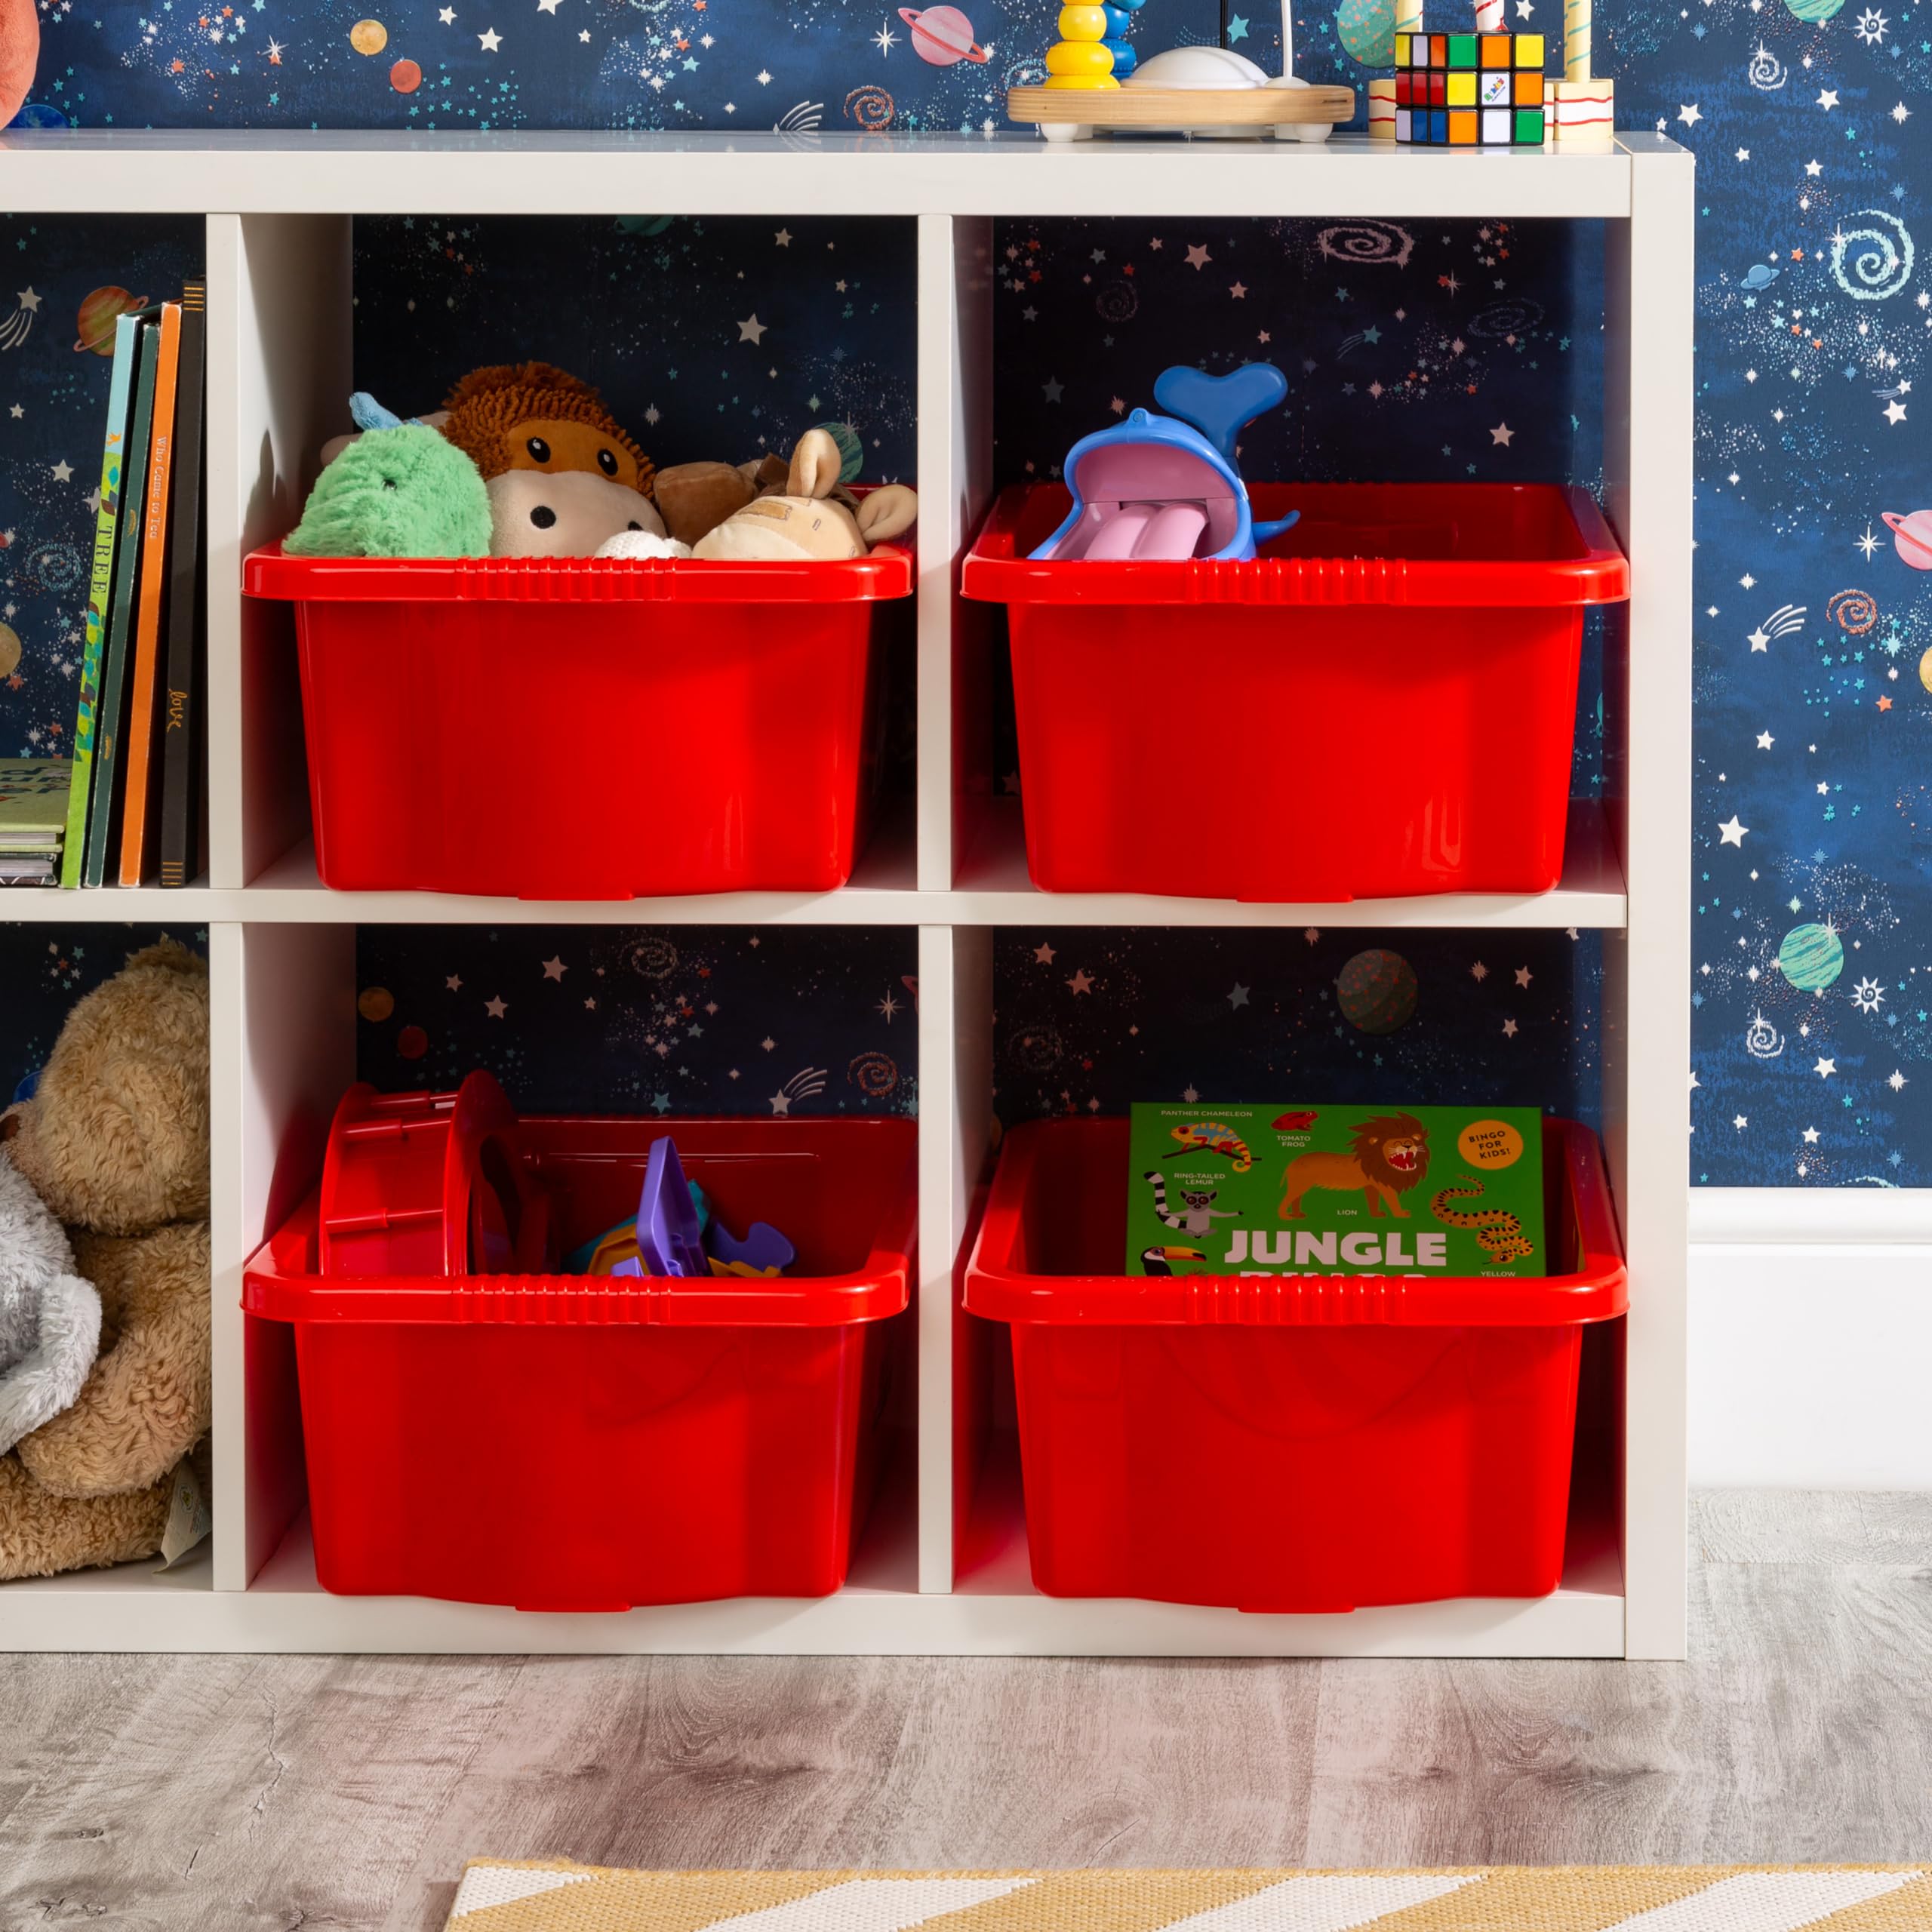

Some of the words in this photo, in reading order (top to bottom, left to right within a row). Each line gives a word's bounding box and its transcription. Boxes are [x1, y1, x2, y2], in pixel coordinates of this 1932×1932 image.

[156, 436, 167, 462] Who
[153, 466, 165, 498] Came
[152, 502, 160, 513] to
[149, 517, 161, 538] Tea
[92, 525, 112, 593] TREE
[167, 688, 188, 734] love
[1469, 1131, 1506, 1143] BINGO
[1479, 1140, 1502, 1150] FOR
[1479, 1148, 1510, 1159] KIDS!
[1224, 1230, 1447, 1266] JUNGLE
